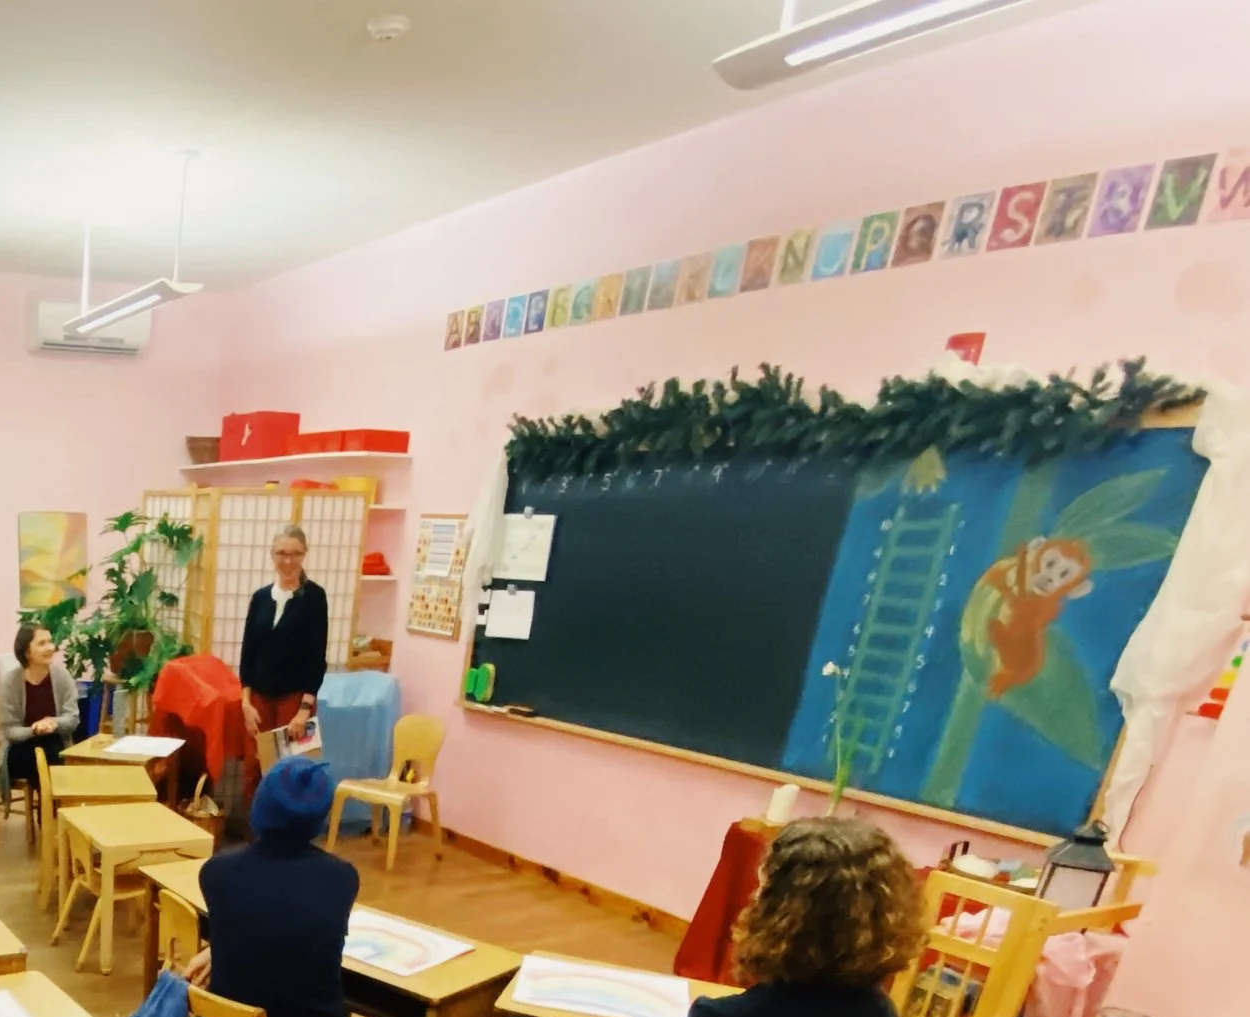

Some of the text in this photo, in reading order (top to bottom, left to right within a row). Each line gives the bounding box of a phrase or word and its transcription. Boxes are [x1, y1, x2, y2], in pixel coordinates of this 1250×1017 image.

[780, 236, 811, 277] N
[861, 221, 891, 271] P
[949, 201, 984, 250] R
[999, 190, 1036, 242] S
[1165, 167, 1208, 220] V
[653, 469, 663, 487] 7
[710, 464, 722, 483] 9
[925, 624, 935, 639] 4
[916, 654, 926, 669] 5
[902, 700, 911, 714] 7
